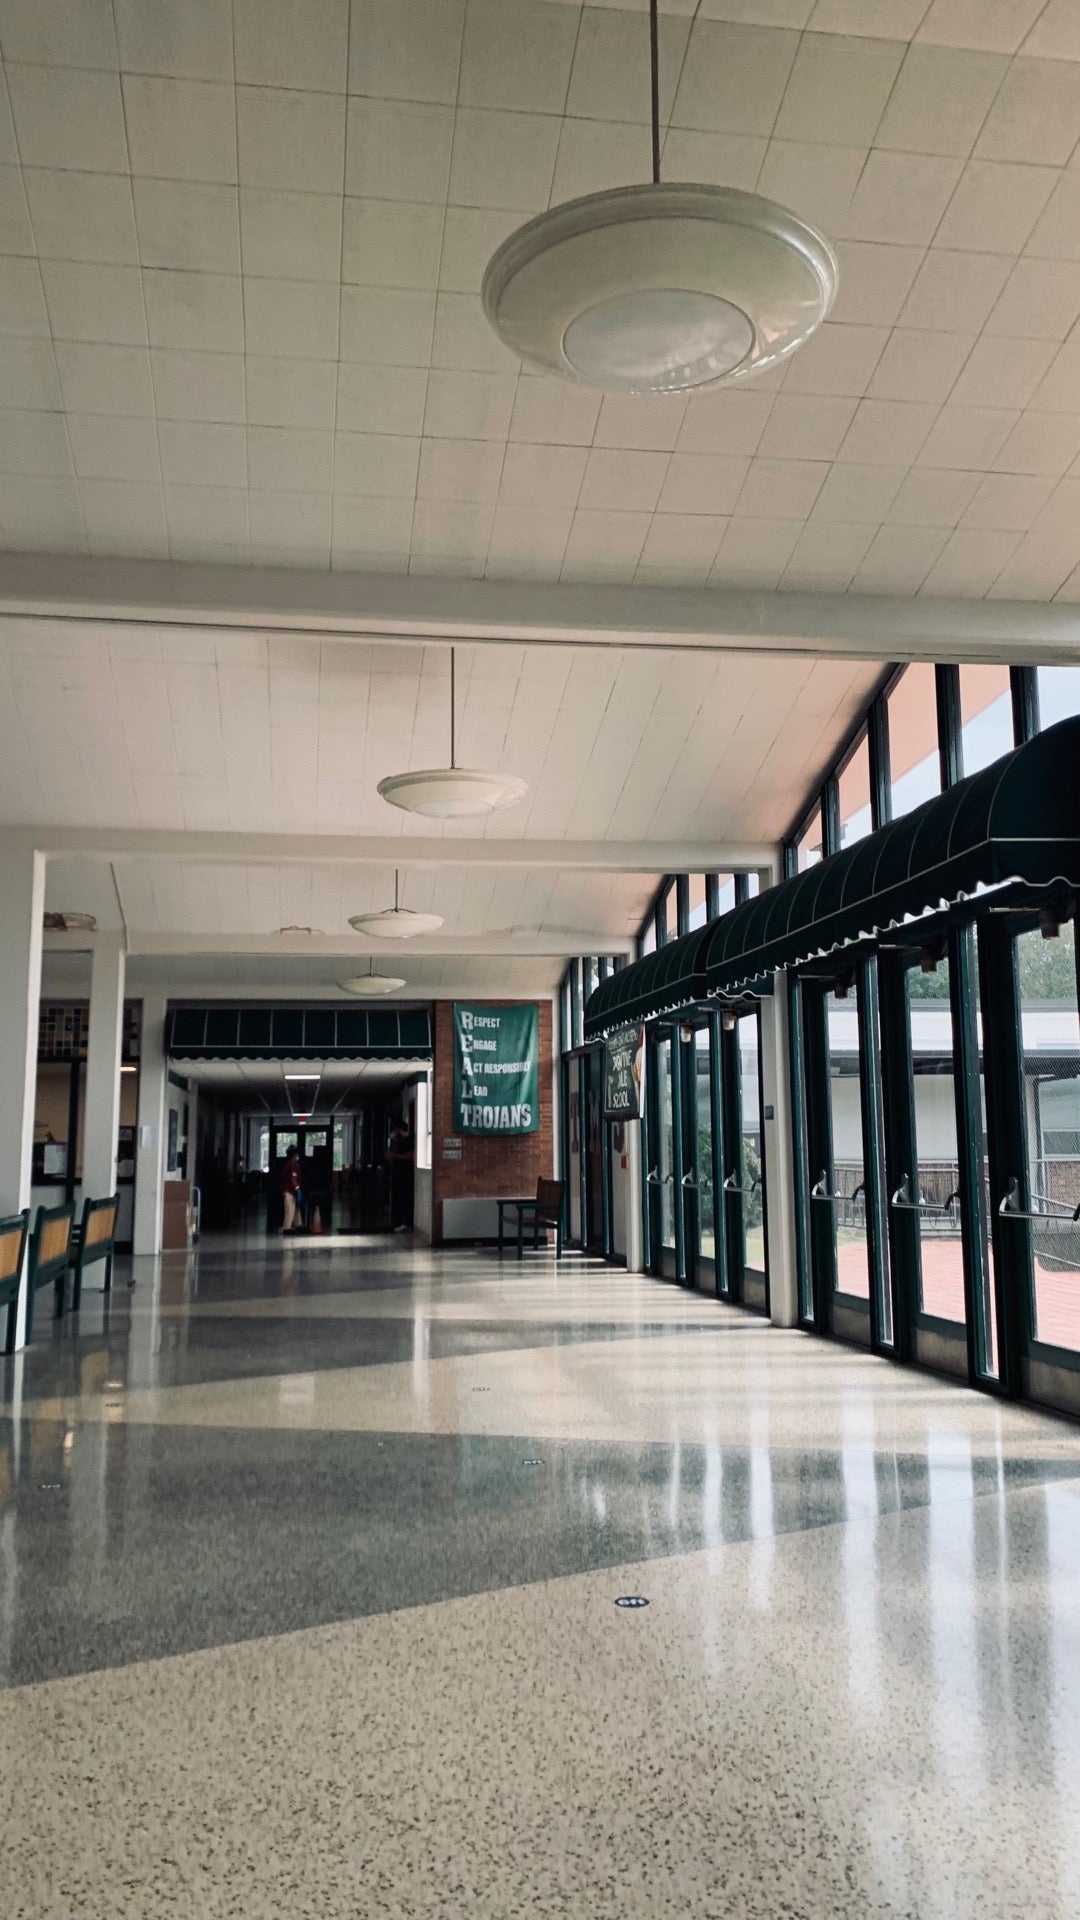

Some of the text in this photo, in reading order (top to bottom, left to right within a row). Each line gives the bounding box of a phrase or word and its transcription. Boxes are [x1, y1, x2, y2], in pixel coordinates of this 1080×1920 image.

[461, 1011, 500, 1030] RESPECT
[461, 1034, 497, 1053] ENGAGE
[462, 1057, 482, 1076] ACT
[462, 1080, 488, 1098] LEAD
[461, 1104, 531, 1129] TROJANS
